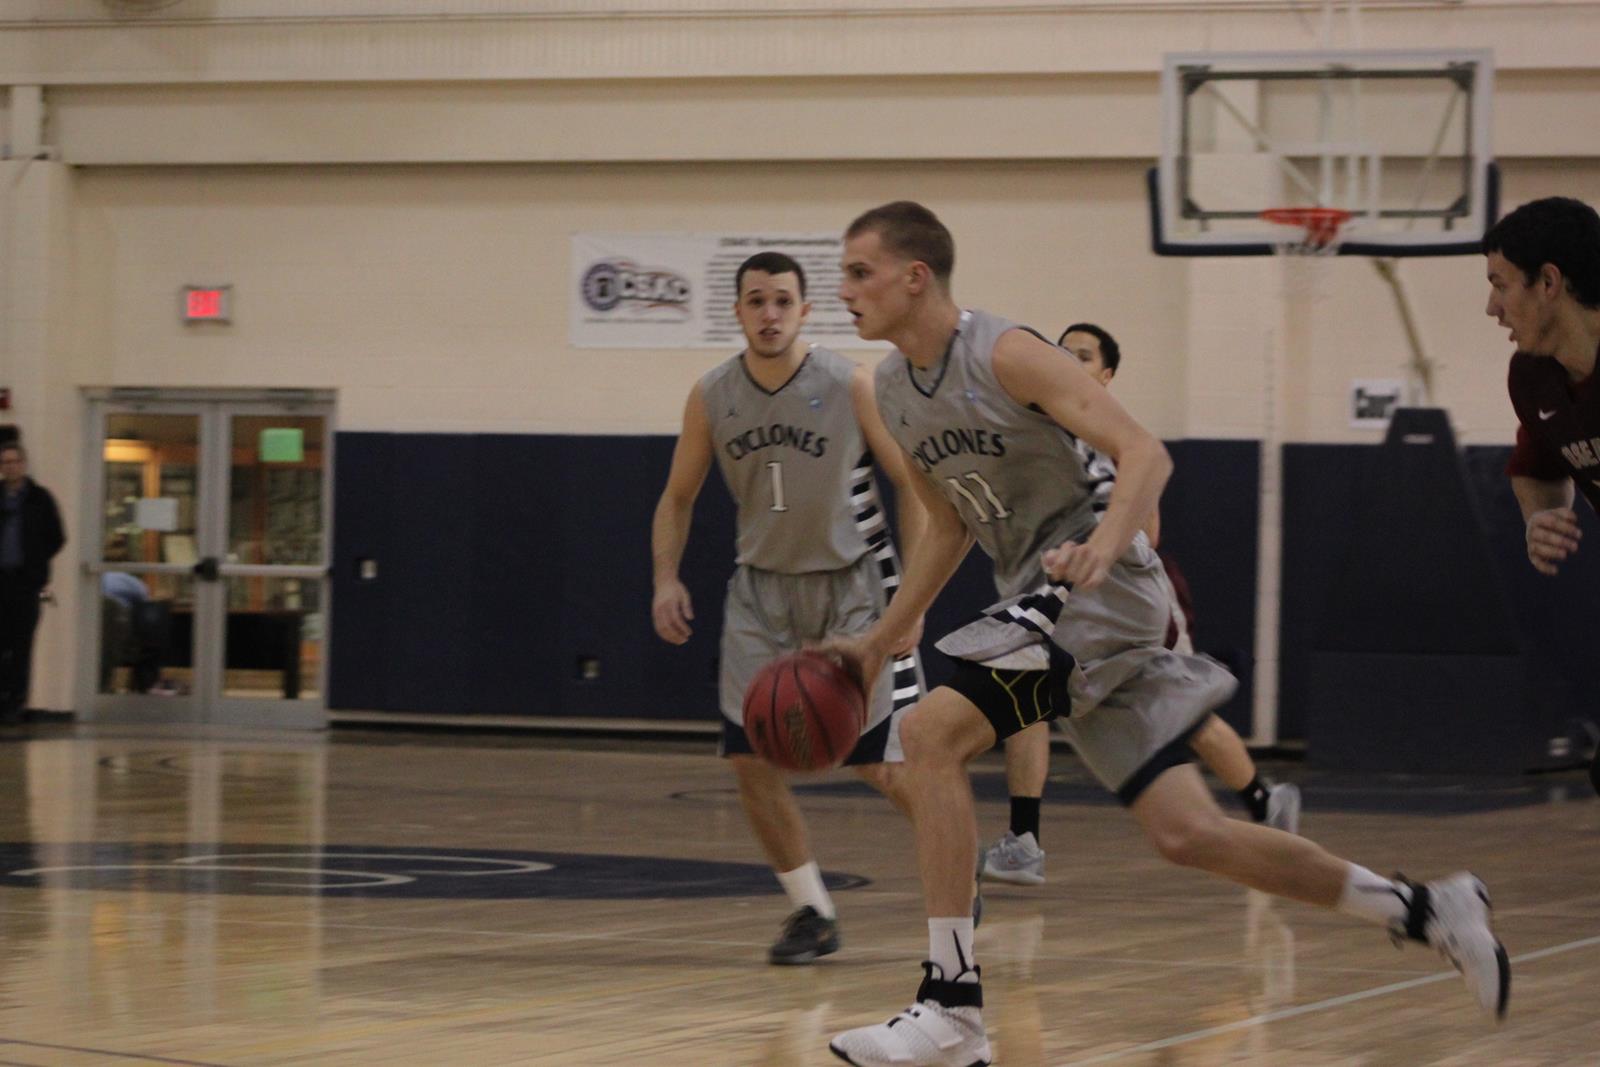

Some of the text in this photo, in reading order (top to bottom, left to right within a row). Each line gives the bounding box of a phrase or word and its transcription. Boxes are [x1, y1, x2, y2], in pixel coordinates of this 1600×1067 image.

[912, 428, 1006, 473] YCLONES
[766, 460, 788, 512] 1
[945, 471, 1015, 524] 11
